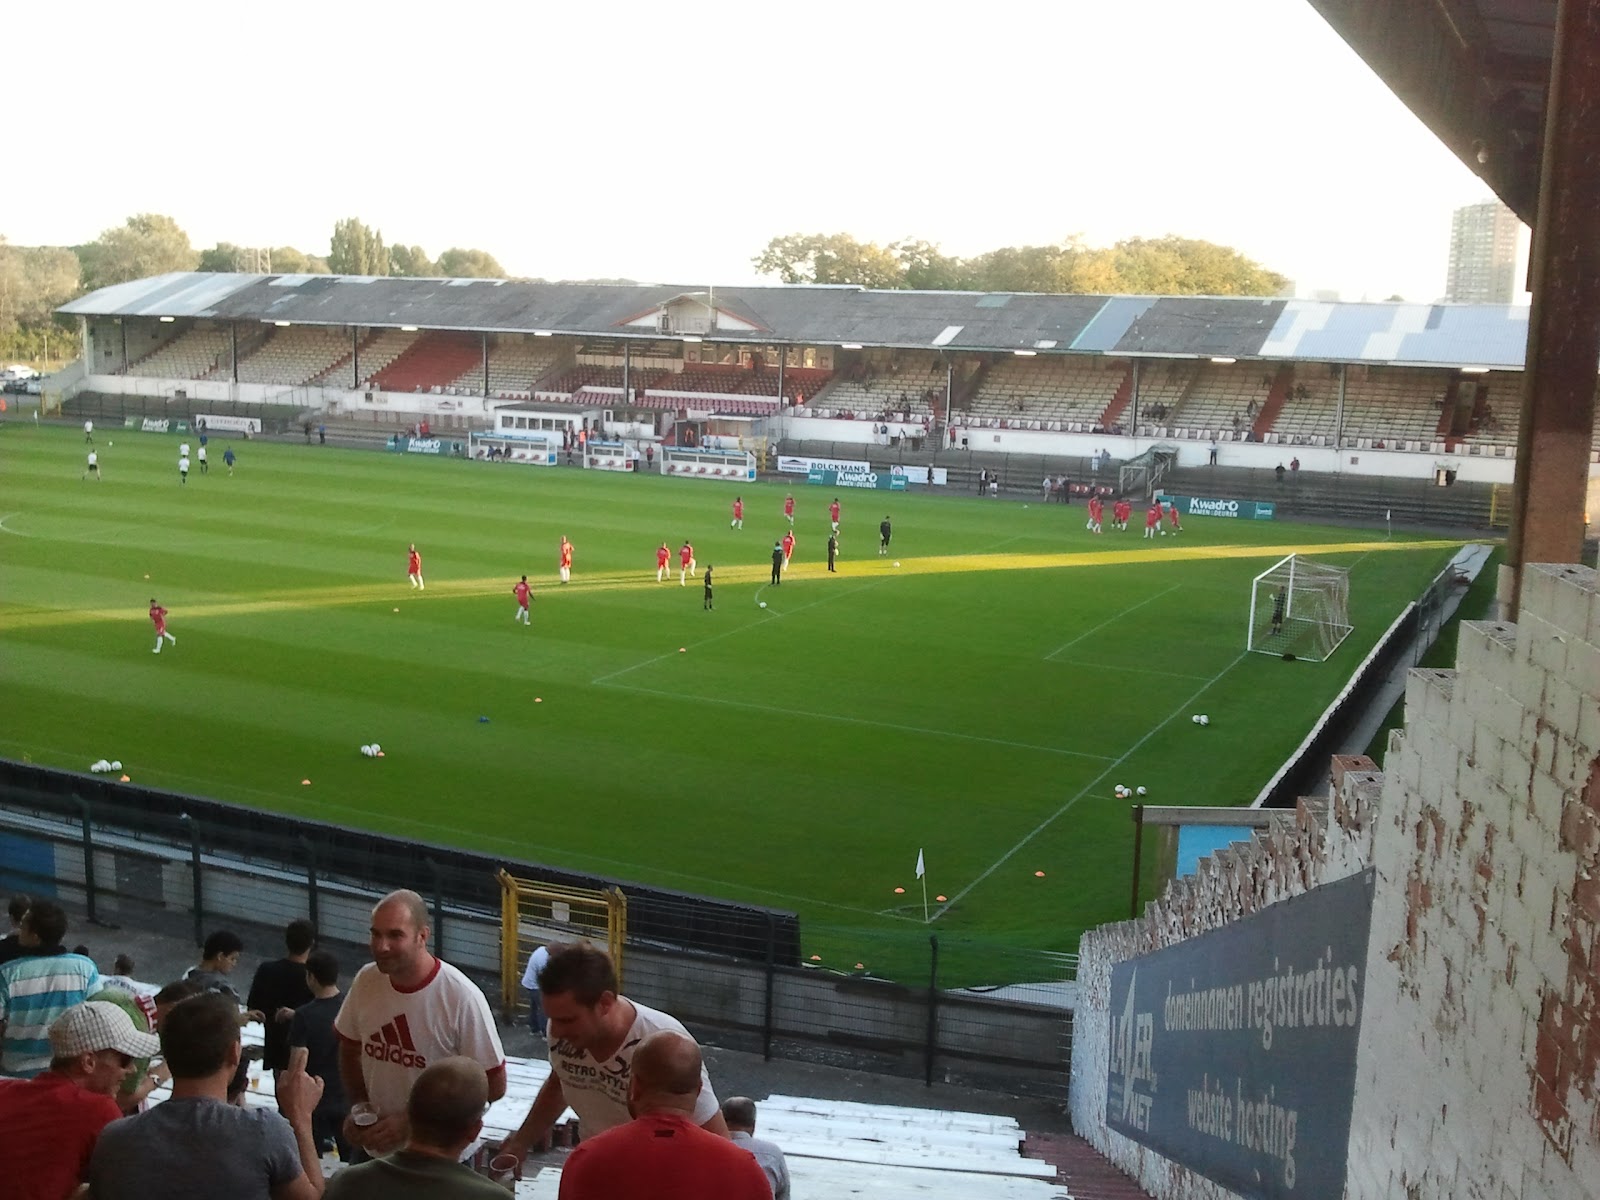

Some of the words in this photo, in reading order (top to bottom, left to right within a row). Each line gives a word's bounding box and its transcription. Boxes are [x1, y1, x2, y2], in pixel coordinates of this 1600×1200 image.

[811, 462, 866, 473] BOLCKMANS
[1165, 980, 1243, 1031] domeinnamen
[1248, 945, 1358, 1050] registraties
[365, 1043, 426, 1069] adidas
[561, 1060, 597, 1077] RETRO
[1129, 1091, 1153, 1133] NET
[1187, 1072, 1232, 1142] website
[1237, 1077, 1298, 1190] hosting
